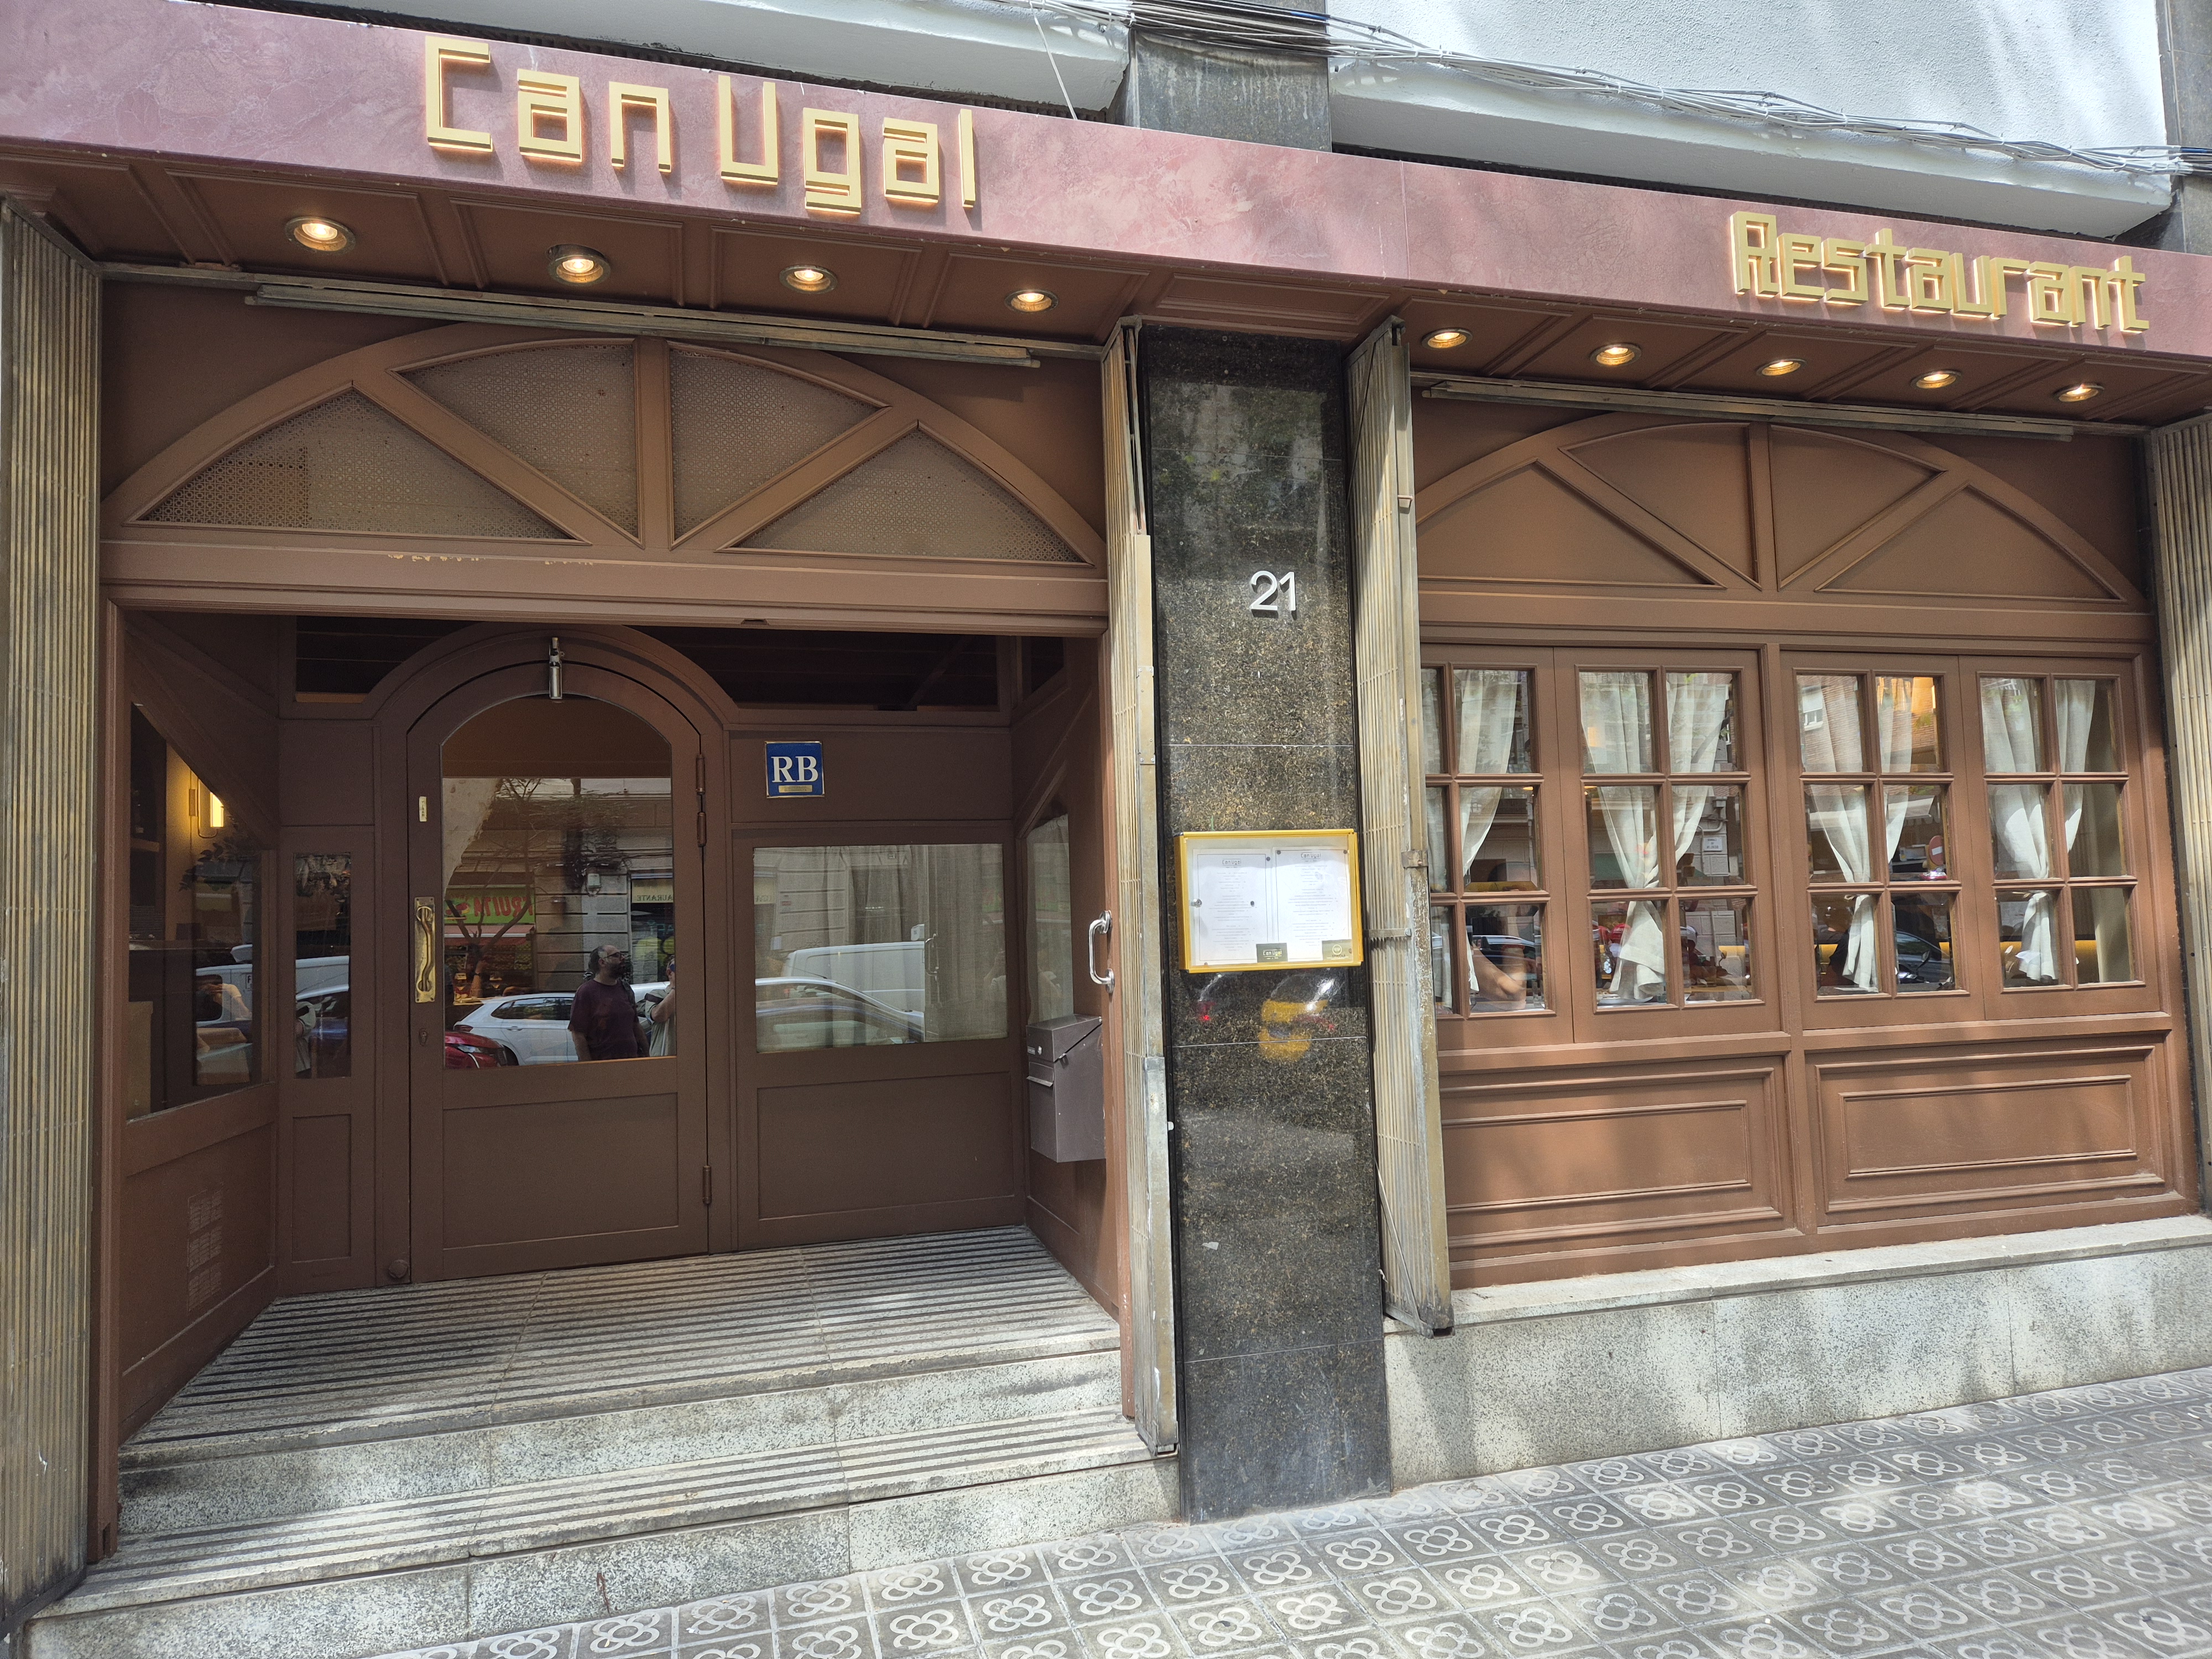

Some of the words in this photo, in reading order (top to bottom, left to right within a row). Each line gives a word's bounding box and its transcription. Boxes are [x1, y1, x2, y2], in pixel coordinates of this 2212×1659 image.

[426, 35, 672, 173] Can
[718, 75, 977, 215] Ugal
[1730, 210, 2150, 334] Restaurant
[1250, 570, 1297, 613] 21
[771, 756, 818, 782] RB
